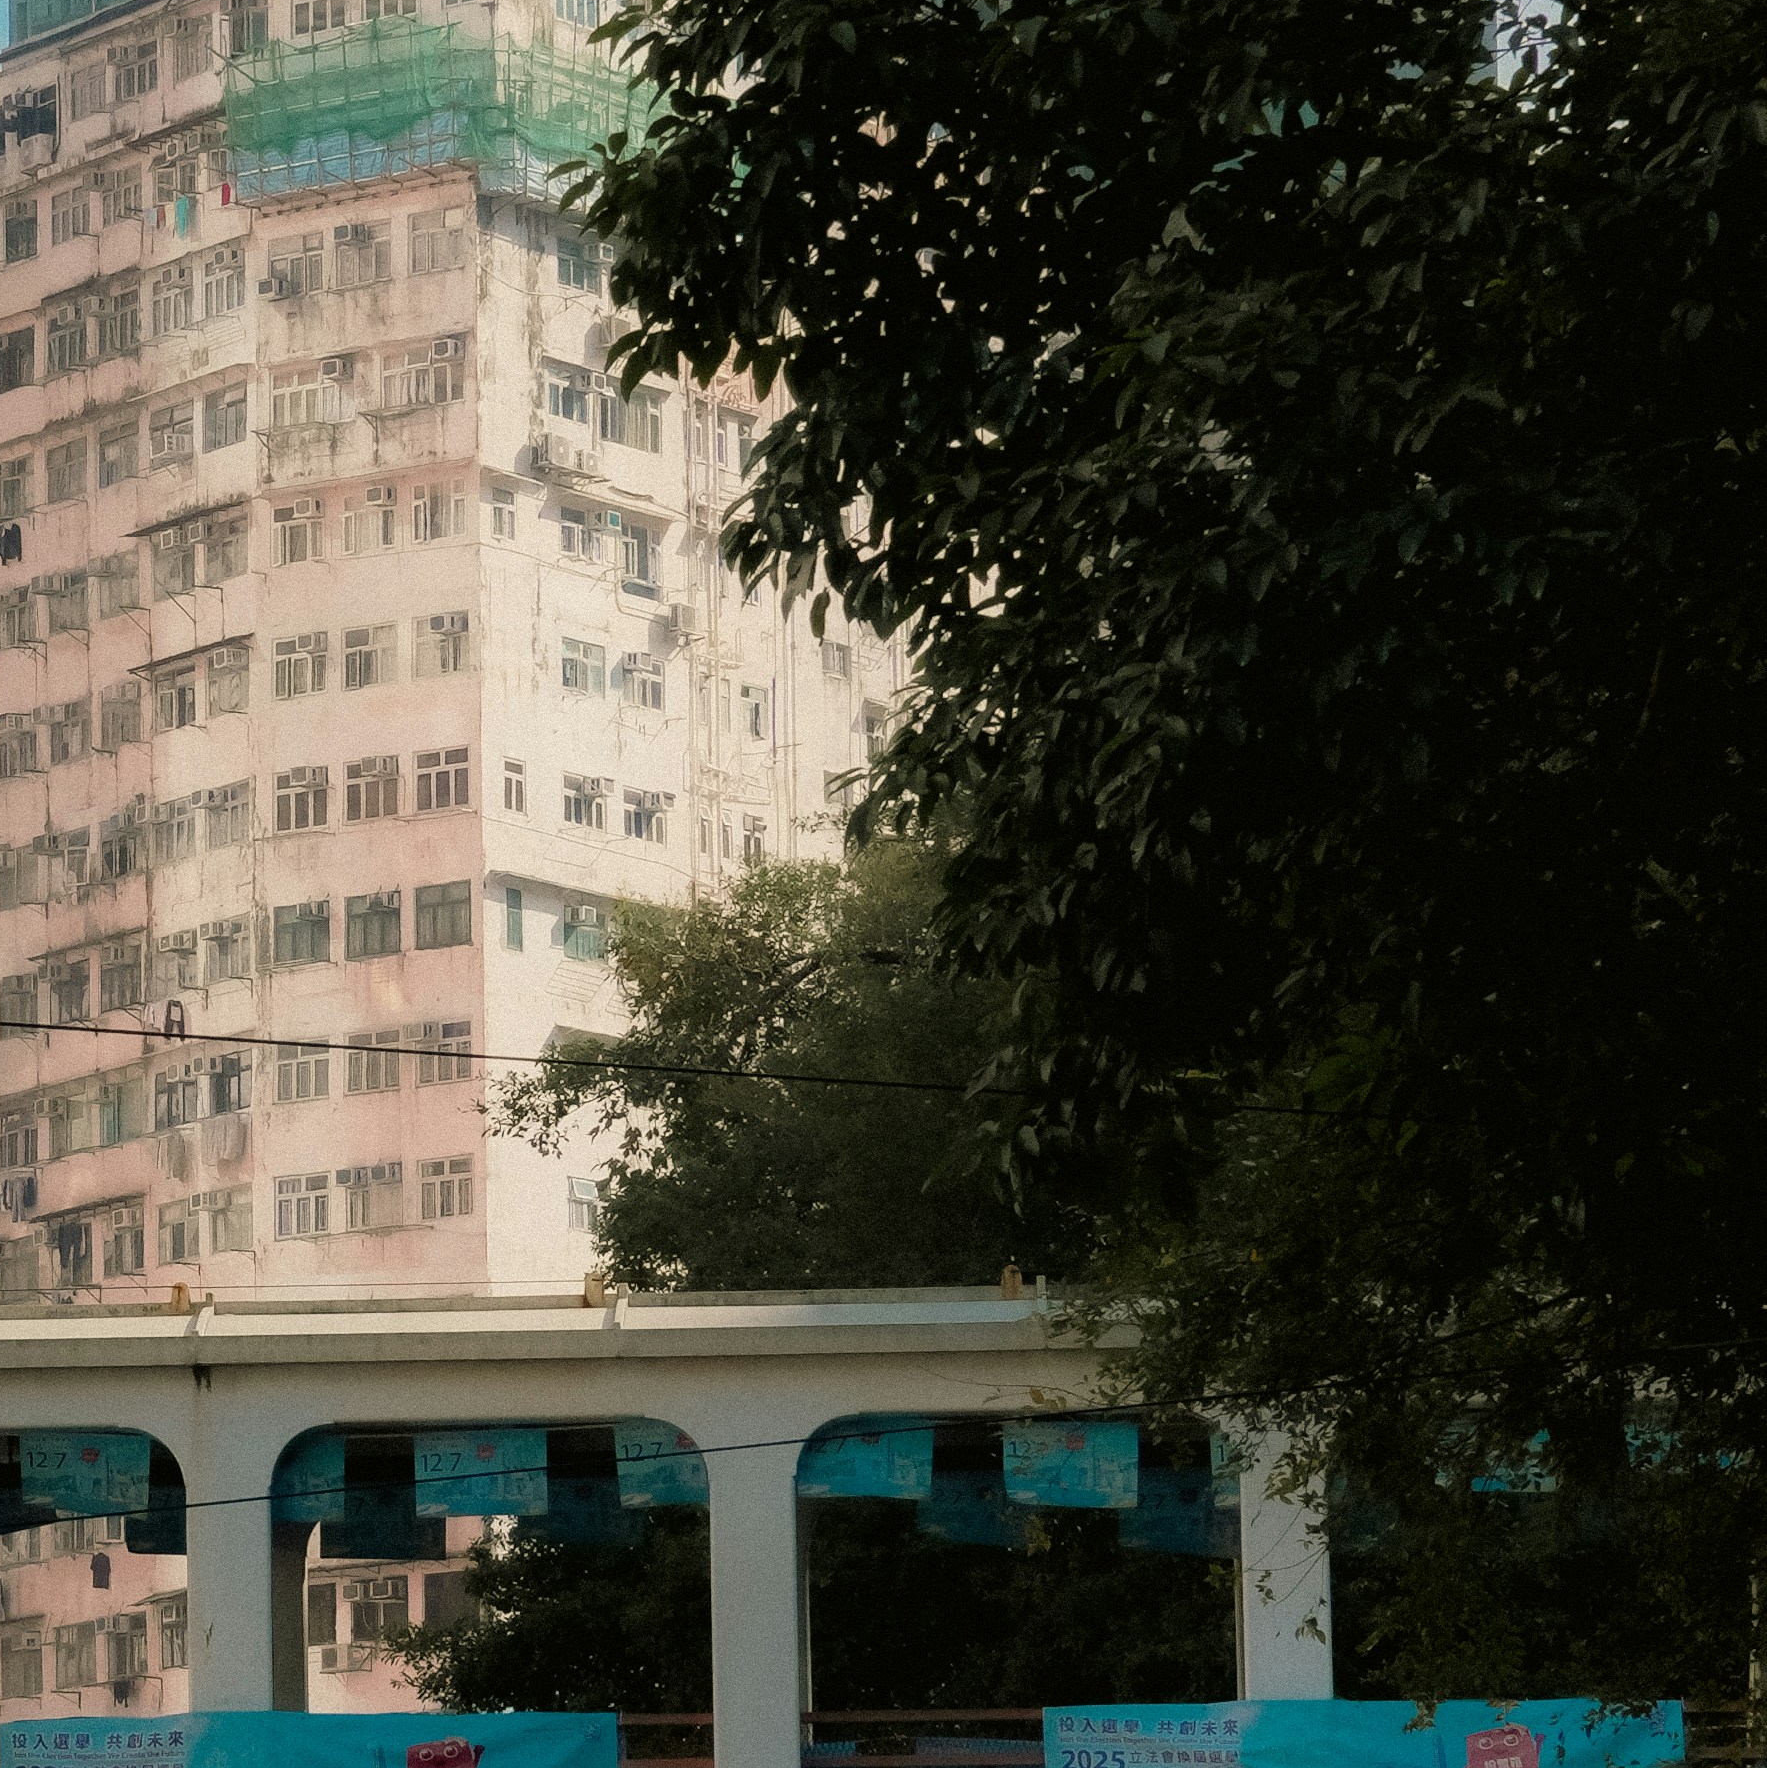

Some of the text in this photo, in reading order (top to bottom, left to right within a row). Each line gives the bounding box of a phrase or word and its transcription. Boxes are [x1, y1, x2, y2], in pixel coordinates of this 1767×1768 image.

[27, 1452, 66, 1470] 12 7
[622, 1442, 663, 1462] 12 7
[422, 1453, 463, 1473] 12 7
[1059, 1717, 1239, 1737] 投入選舉 共創未來
[12, 1730, 185, 1750] 投入選舉 共創未來
